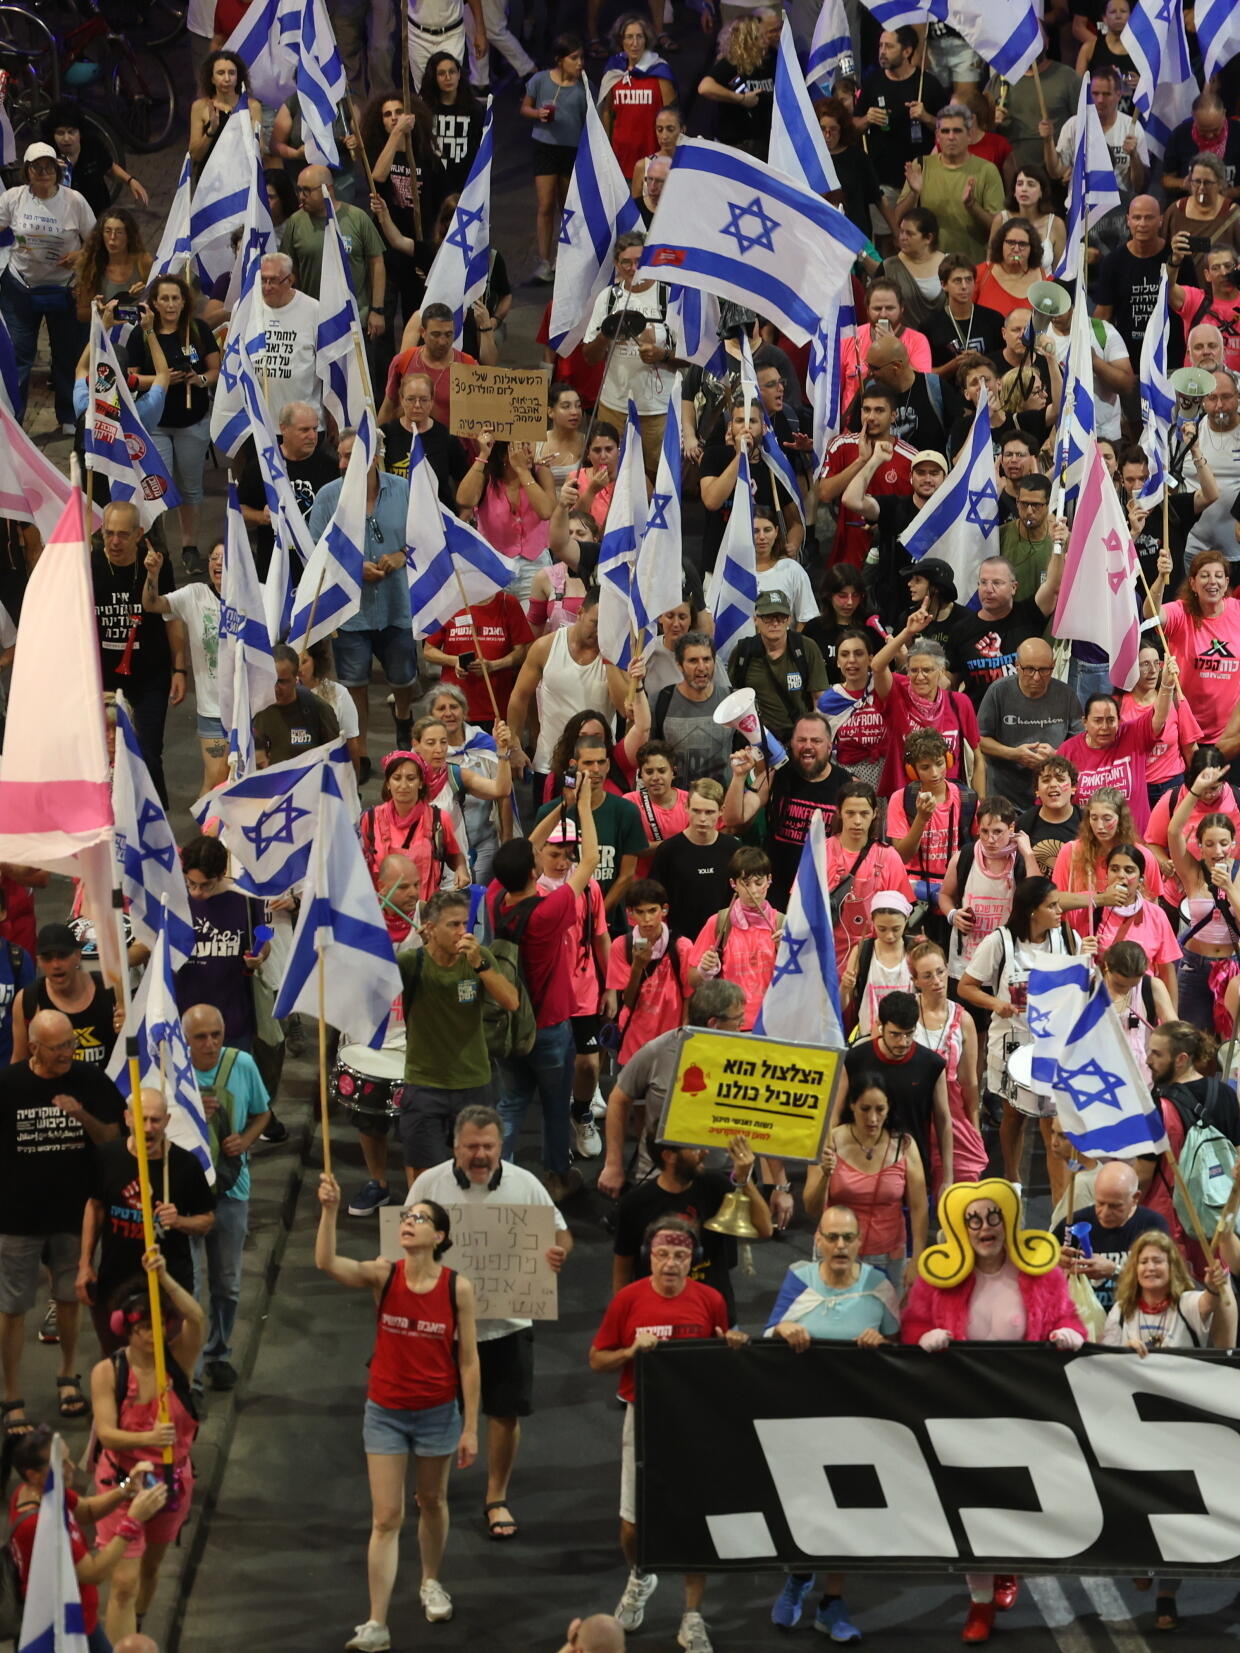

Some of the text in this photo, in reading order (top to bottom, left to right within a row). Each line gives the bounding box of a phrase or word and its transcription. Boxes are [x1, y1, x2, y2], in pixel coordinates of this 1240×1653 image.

[494, 375, 543, 385] המשאלות
[450, 627, 472, 637] נשים
[967, 652, 1019, 670] דמוקרטיה
[1003, 714, 1064, 728] Champion
[723, 1058, 825, 1086] הצלצול הוא
[717, 1080, 820, 1110] בשביל כולנו
[17, 1106, 67, 1120] מוקרטיה
[36, 1116, 67, 1129] כיבוש
